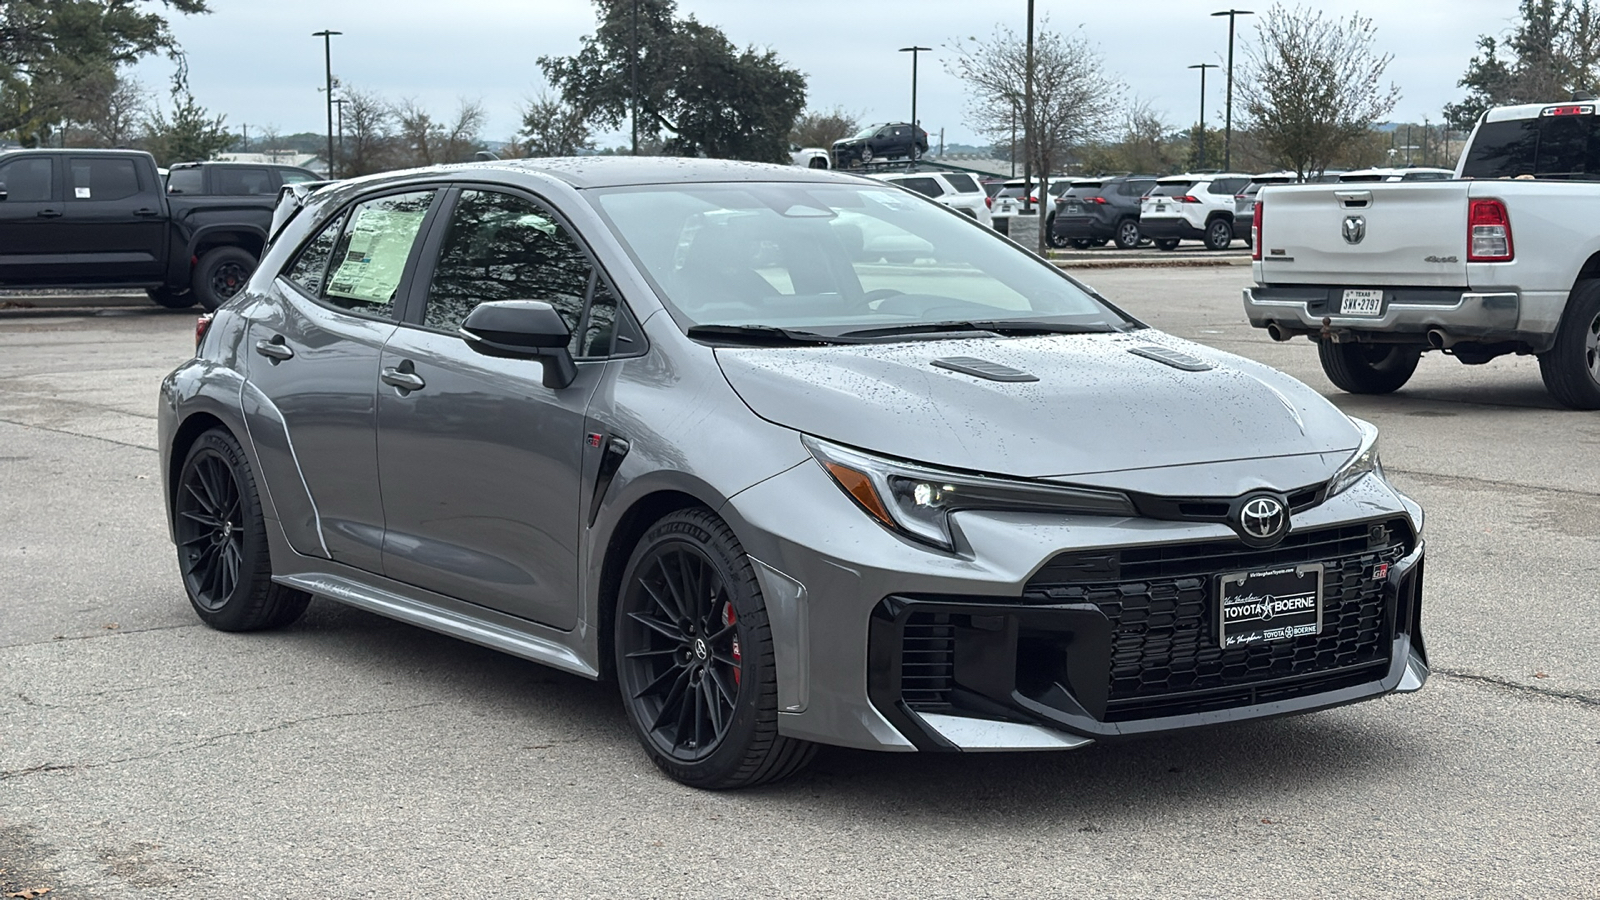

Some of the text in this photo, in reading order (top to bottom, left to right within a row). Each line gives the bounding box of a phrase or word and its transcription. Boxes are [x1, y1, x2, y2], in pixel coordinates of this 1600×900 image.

[659, 522, 709, 543] MICHELIN
[1372, 568, 1387, 580] GR
[1224, 596, 1315, 618] TOYOTA BOERNE
[1263, 630, 1285, 639] TOYOTA
[1293, 625, 1317, 635] BOERNE
